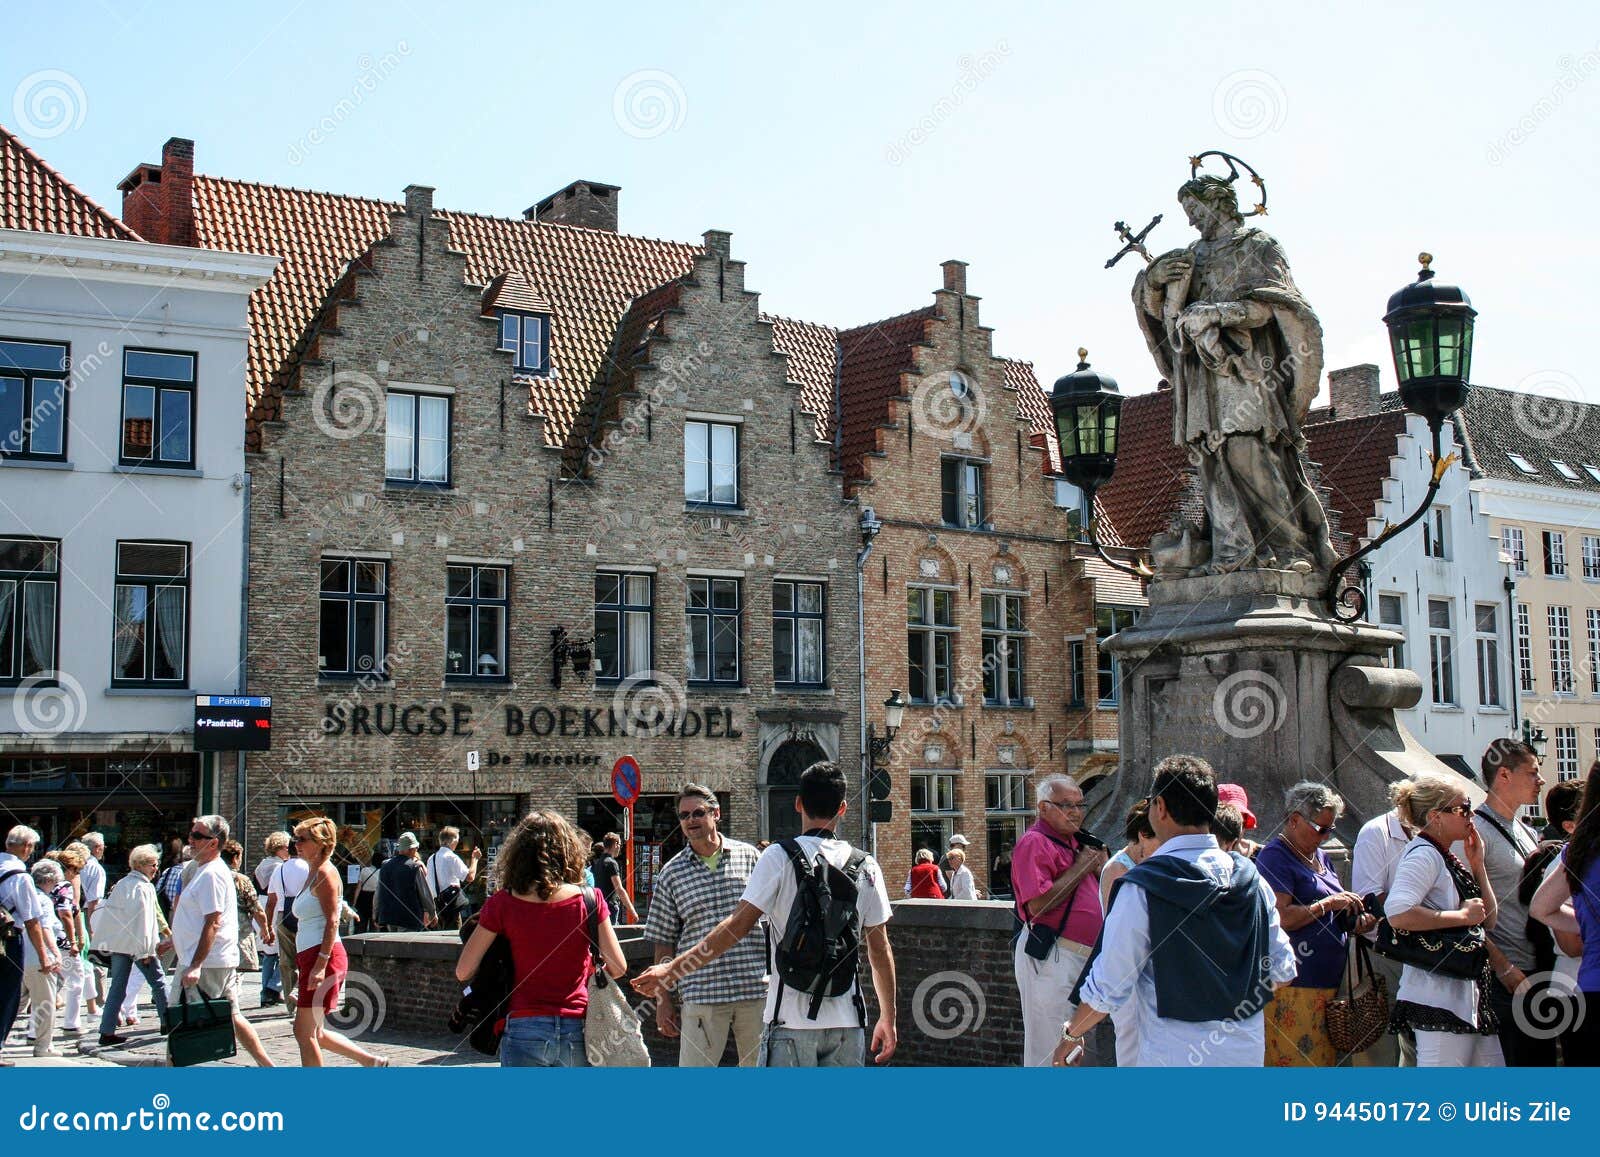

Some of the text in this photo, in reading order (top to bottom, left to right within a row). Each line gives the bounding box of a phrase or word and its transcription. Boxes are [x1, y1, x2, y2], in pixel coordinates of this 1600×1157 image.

[218, 697, 250, 706] Parking
[255, 719, 270, 728] VOL
[322, 702, 474, 736] BRUGSE
[487, 751, 602, 766] De Meester
